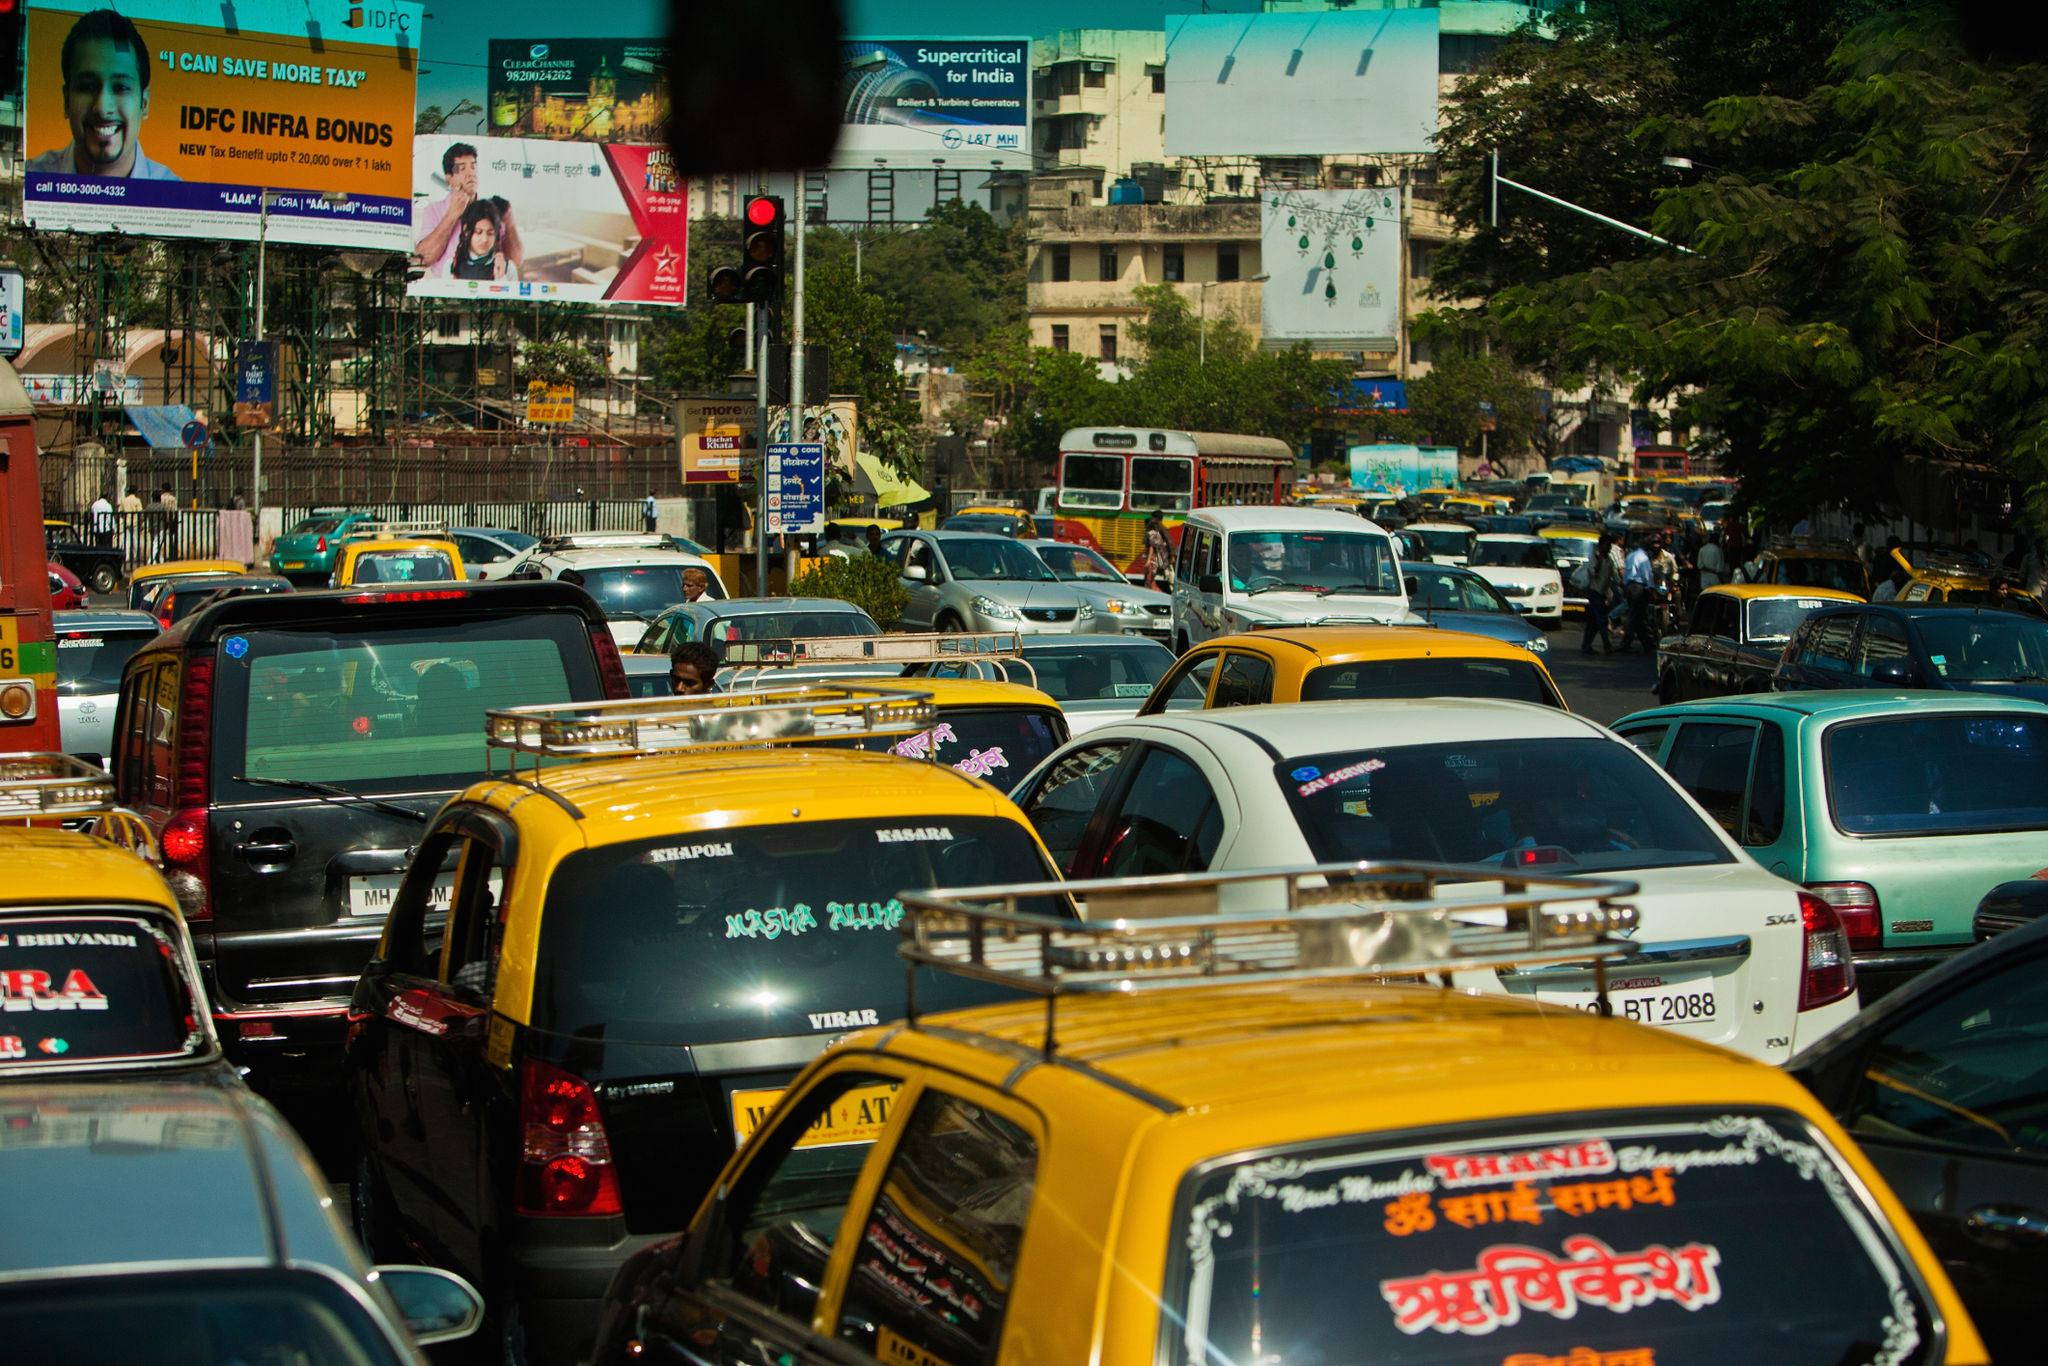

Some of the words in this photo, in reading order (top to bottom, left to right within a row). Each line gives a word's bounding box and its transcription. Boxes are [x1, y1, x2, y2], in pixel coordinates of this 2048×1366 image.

[369, 9, 410, 31] IDFC
[917, 48, 1022, 66] Supercritical
[180, 52, 218, 73] CAN
[222, 57, 268, 79] SAVE
[272, 62, 322, 84] MORE
[946, 70, 968, 83] for
[972, 68, 1015, 84] India
[897, 98, 926, 107] Boilers
[928, 98, 936, 107] &
[937, 98, 970, 107] Turbine
[971, 98, 1020, 107] Generators
[179, 105, 235, 133] IDFC
[242, 110, 309, 139] INFRA
[316, 117, 394, 147] BONDS
[967, 133, 992, 145] L&T
[996, 134, 1018, 145] MHI
[179, 143, 207, 157] NEW
[209, 145, 226, 158] Tax
[228, 146, 263, 161] Benefit
[266, 150, 288, 165] upto
[298, 153, 330, 167] 20,000
[332, 157, 353, 168] over
[364, 159, 369, 169] 1
[371, 160, 392, 172] lakh
[36, 182, 53, 193] call
[55, 183, 126, 197] 1800-3000-4332
[278, 196, 298, 208] ICRA
[362, 204, 380, 214] from
[380, 205, 404, 217] FITCH
[702, 405, 742, 416] more
[875, 827, 954, 843] KASARA
[651, 842, 734, 862] KHAPOLI
[364, 888, 391, 906] MH
[1765, 913, 1797, 926] SX4
[17, 933, 138, 947] BHIVANDI
[1624, 998, 1656, 1022] BT
[1661, 992, 1716, 1021] 2088
[808, 1009, 879, 1029] VIRAR
[856, 1096, 893, 1126] AT
[1338, 1168, 1437, 1203] Mumbai
[1423, 1138, 1618, 1190] THANE
[1438, 1178, 1544, 1228] साई
[1547, 1164, 1677, 1217] समर्थ
